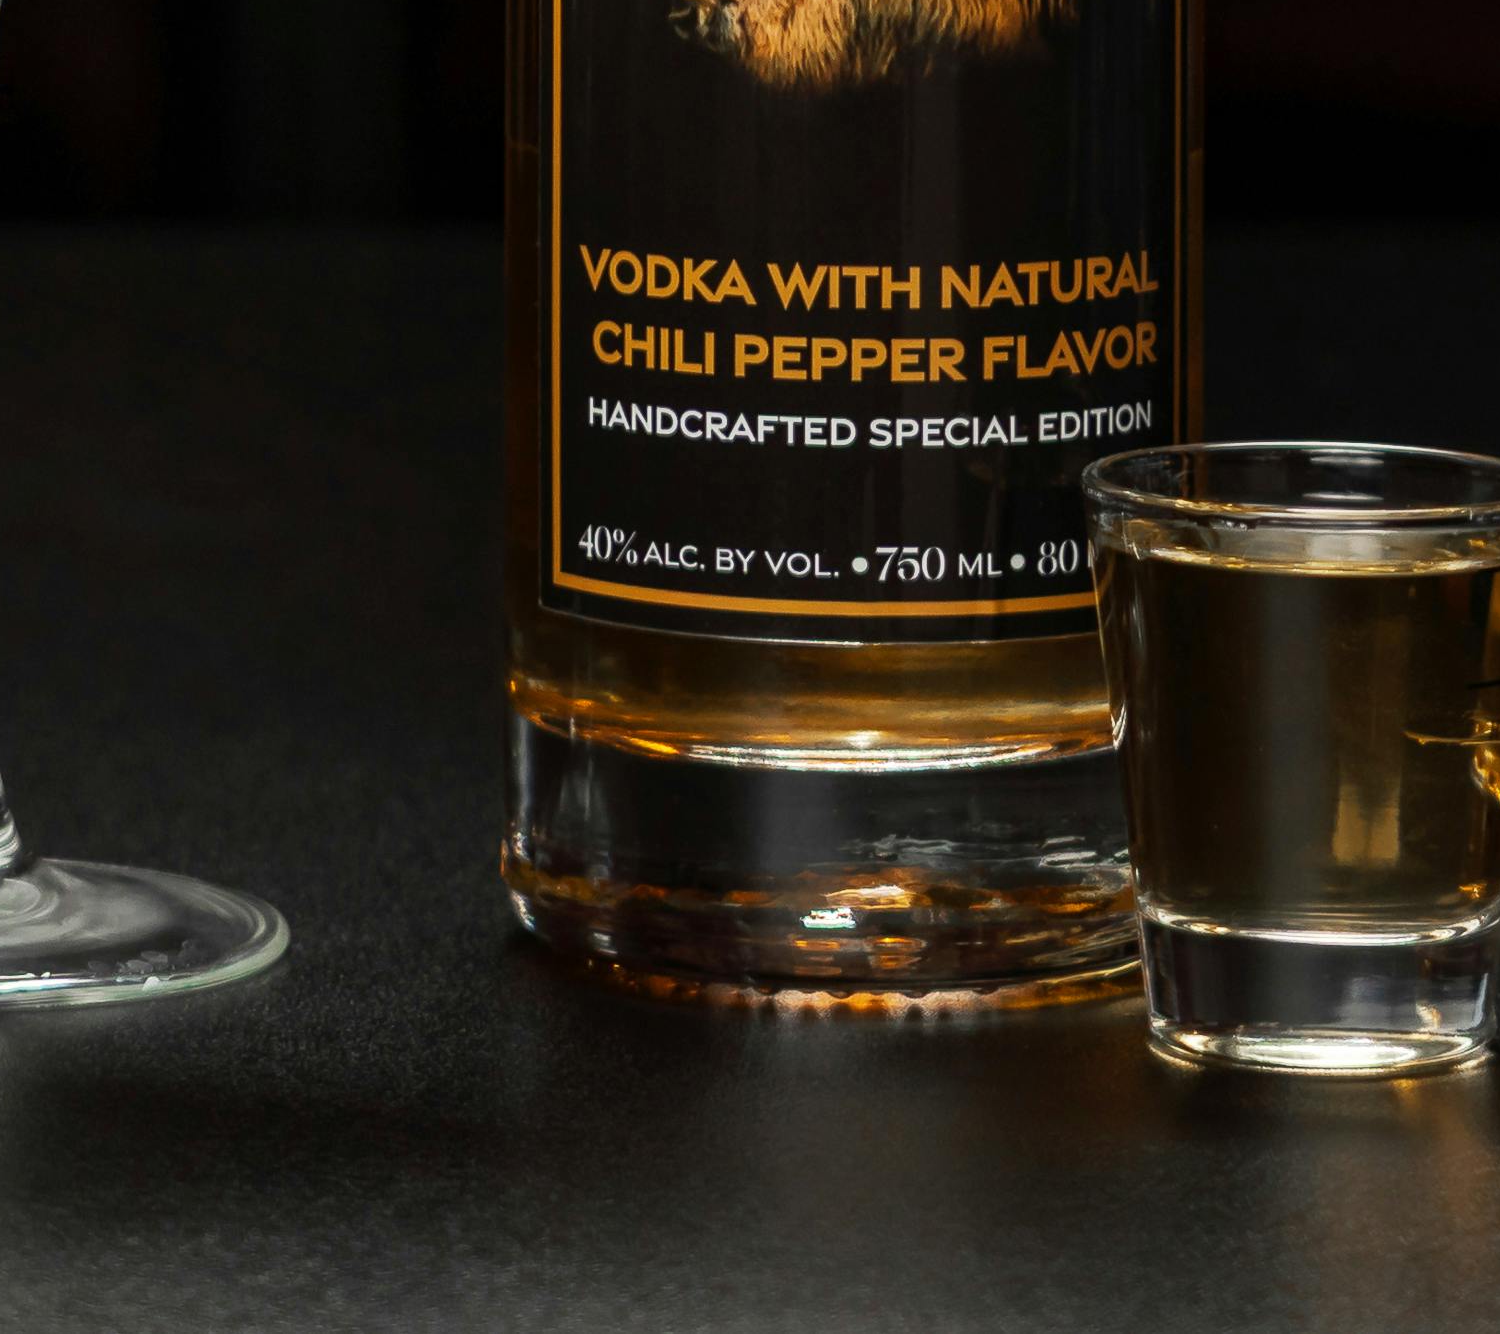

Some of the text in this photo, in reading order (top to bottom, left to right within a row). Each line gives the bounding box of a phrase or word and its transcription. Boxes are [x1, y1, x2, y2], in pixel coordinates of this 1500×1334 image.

[580, 244, 1159, 311] VODKA WITH NATURAL
[592, 320, 1158, 382] CHILI PEPPER FLAVOR
[589, 396, 1152, 447] HANDCRAFTED SPECIAL EDITION
[578, 524, 638, 566] 40%
[643, 541, 706, 571] ALC.
[716, 548, 755, 574] BY
[764, 550, 840, 578] VOL.
[875, 546, 946, 582] 750
[958, 553, 1003, 579] ML
[1037, 539, 1079, 576] 80
